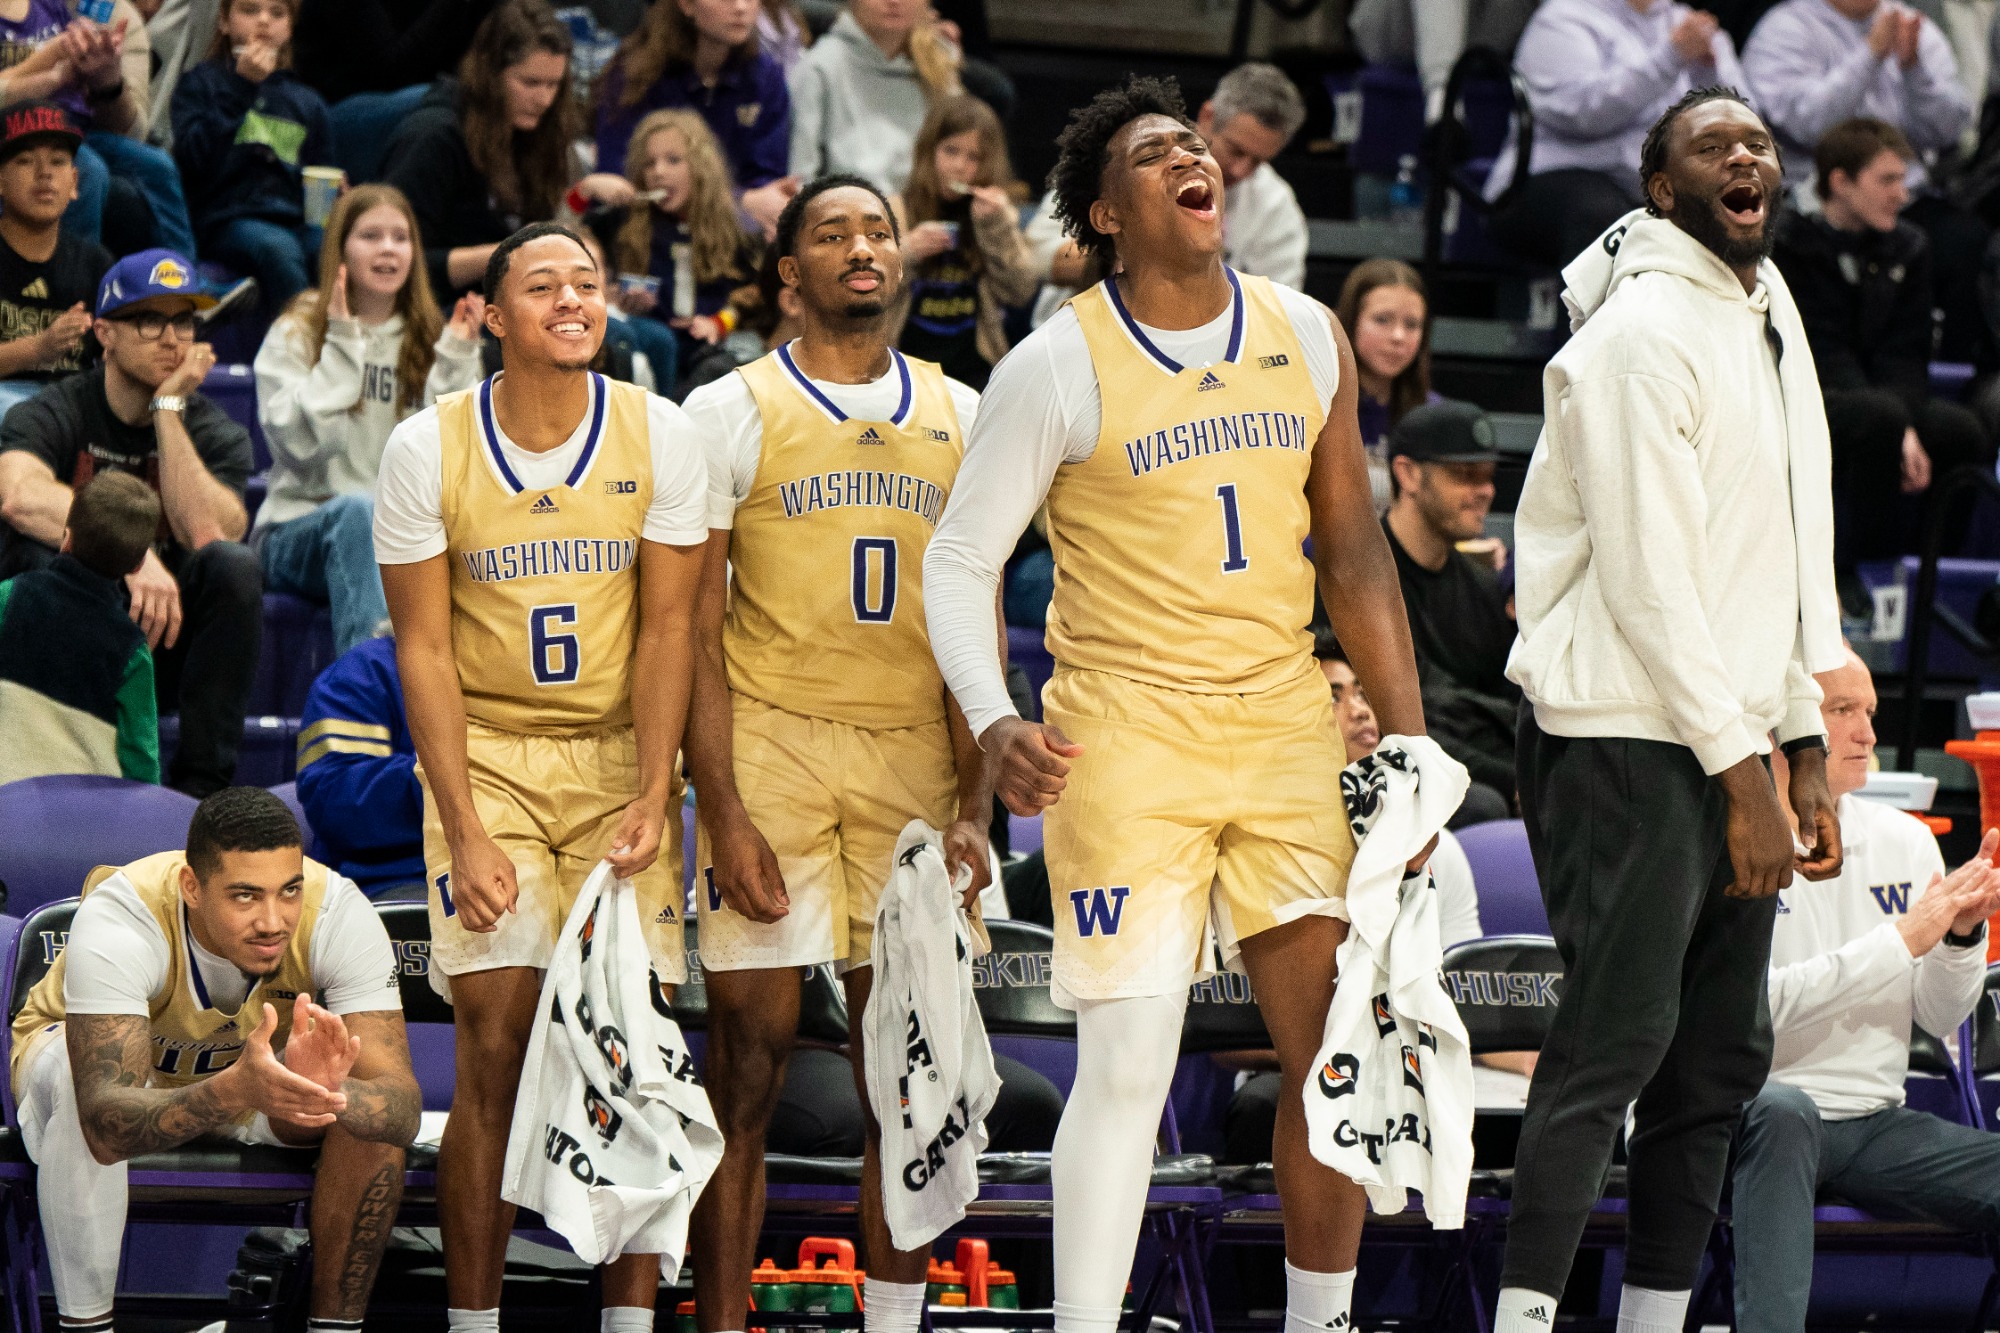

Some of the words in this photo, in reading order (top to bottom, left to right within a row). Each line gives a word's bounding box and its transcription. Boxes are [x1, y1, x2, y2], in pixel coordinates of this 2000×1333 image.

[1197, 381, 1226, 392] adidas
[856, 437, 885, 446] adidas
[1124, 412, 1306, 478] WASHINGTON
[529, 506, 560, 514] adidas
[779, 470, 945, 528] WASHINGTON
[1215, 481, 1250, 575] 1
[462, 537, 637, 583] WASHINGTON
[850, 536, 898, 624] 0
[527, 602, 581, 686] 6
[655, 916, 679, 925] adidas
[1069, 886, 1131, 938] W
[1870, 882, 1912, 915] W
[1522, 1311, 1549, 1324] adidas
